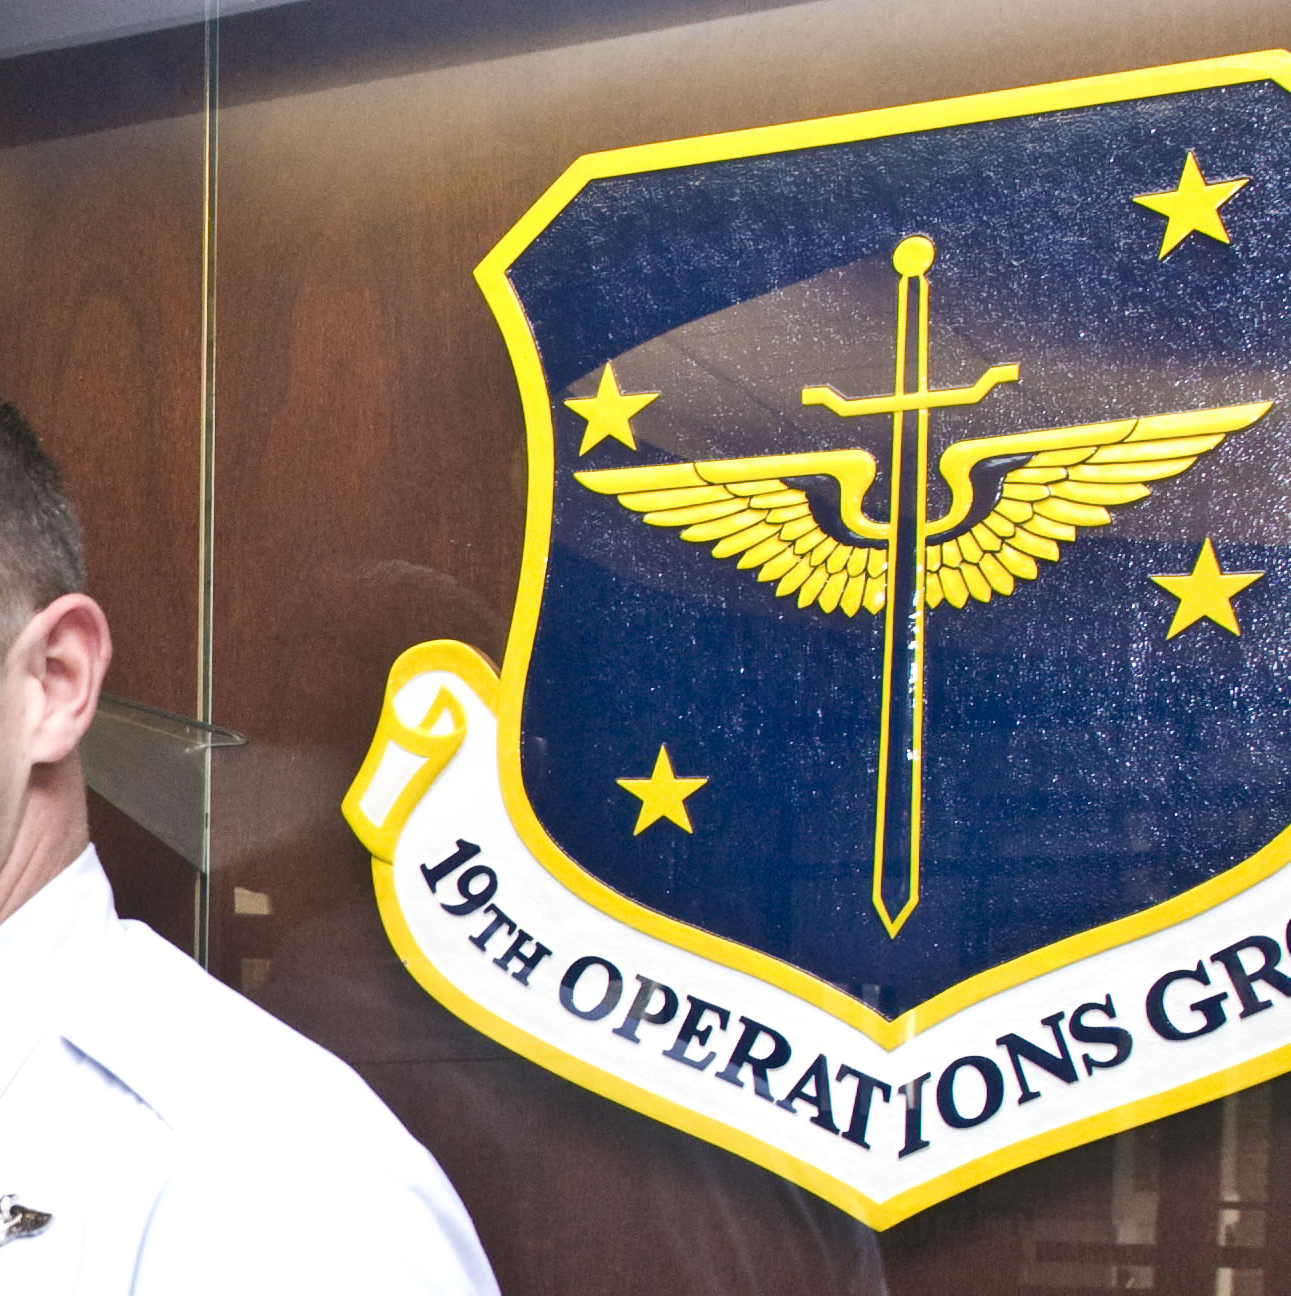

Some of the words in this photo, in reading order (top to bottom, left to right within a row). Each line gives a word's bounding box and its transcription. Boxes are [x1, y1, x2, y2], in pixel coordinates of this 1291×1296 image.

[420, 838, 553, 986] 19TH
[558, 955, 1133, 1158] OPERATIONS
[1145, 918, 1291, 1041] GR
